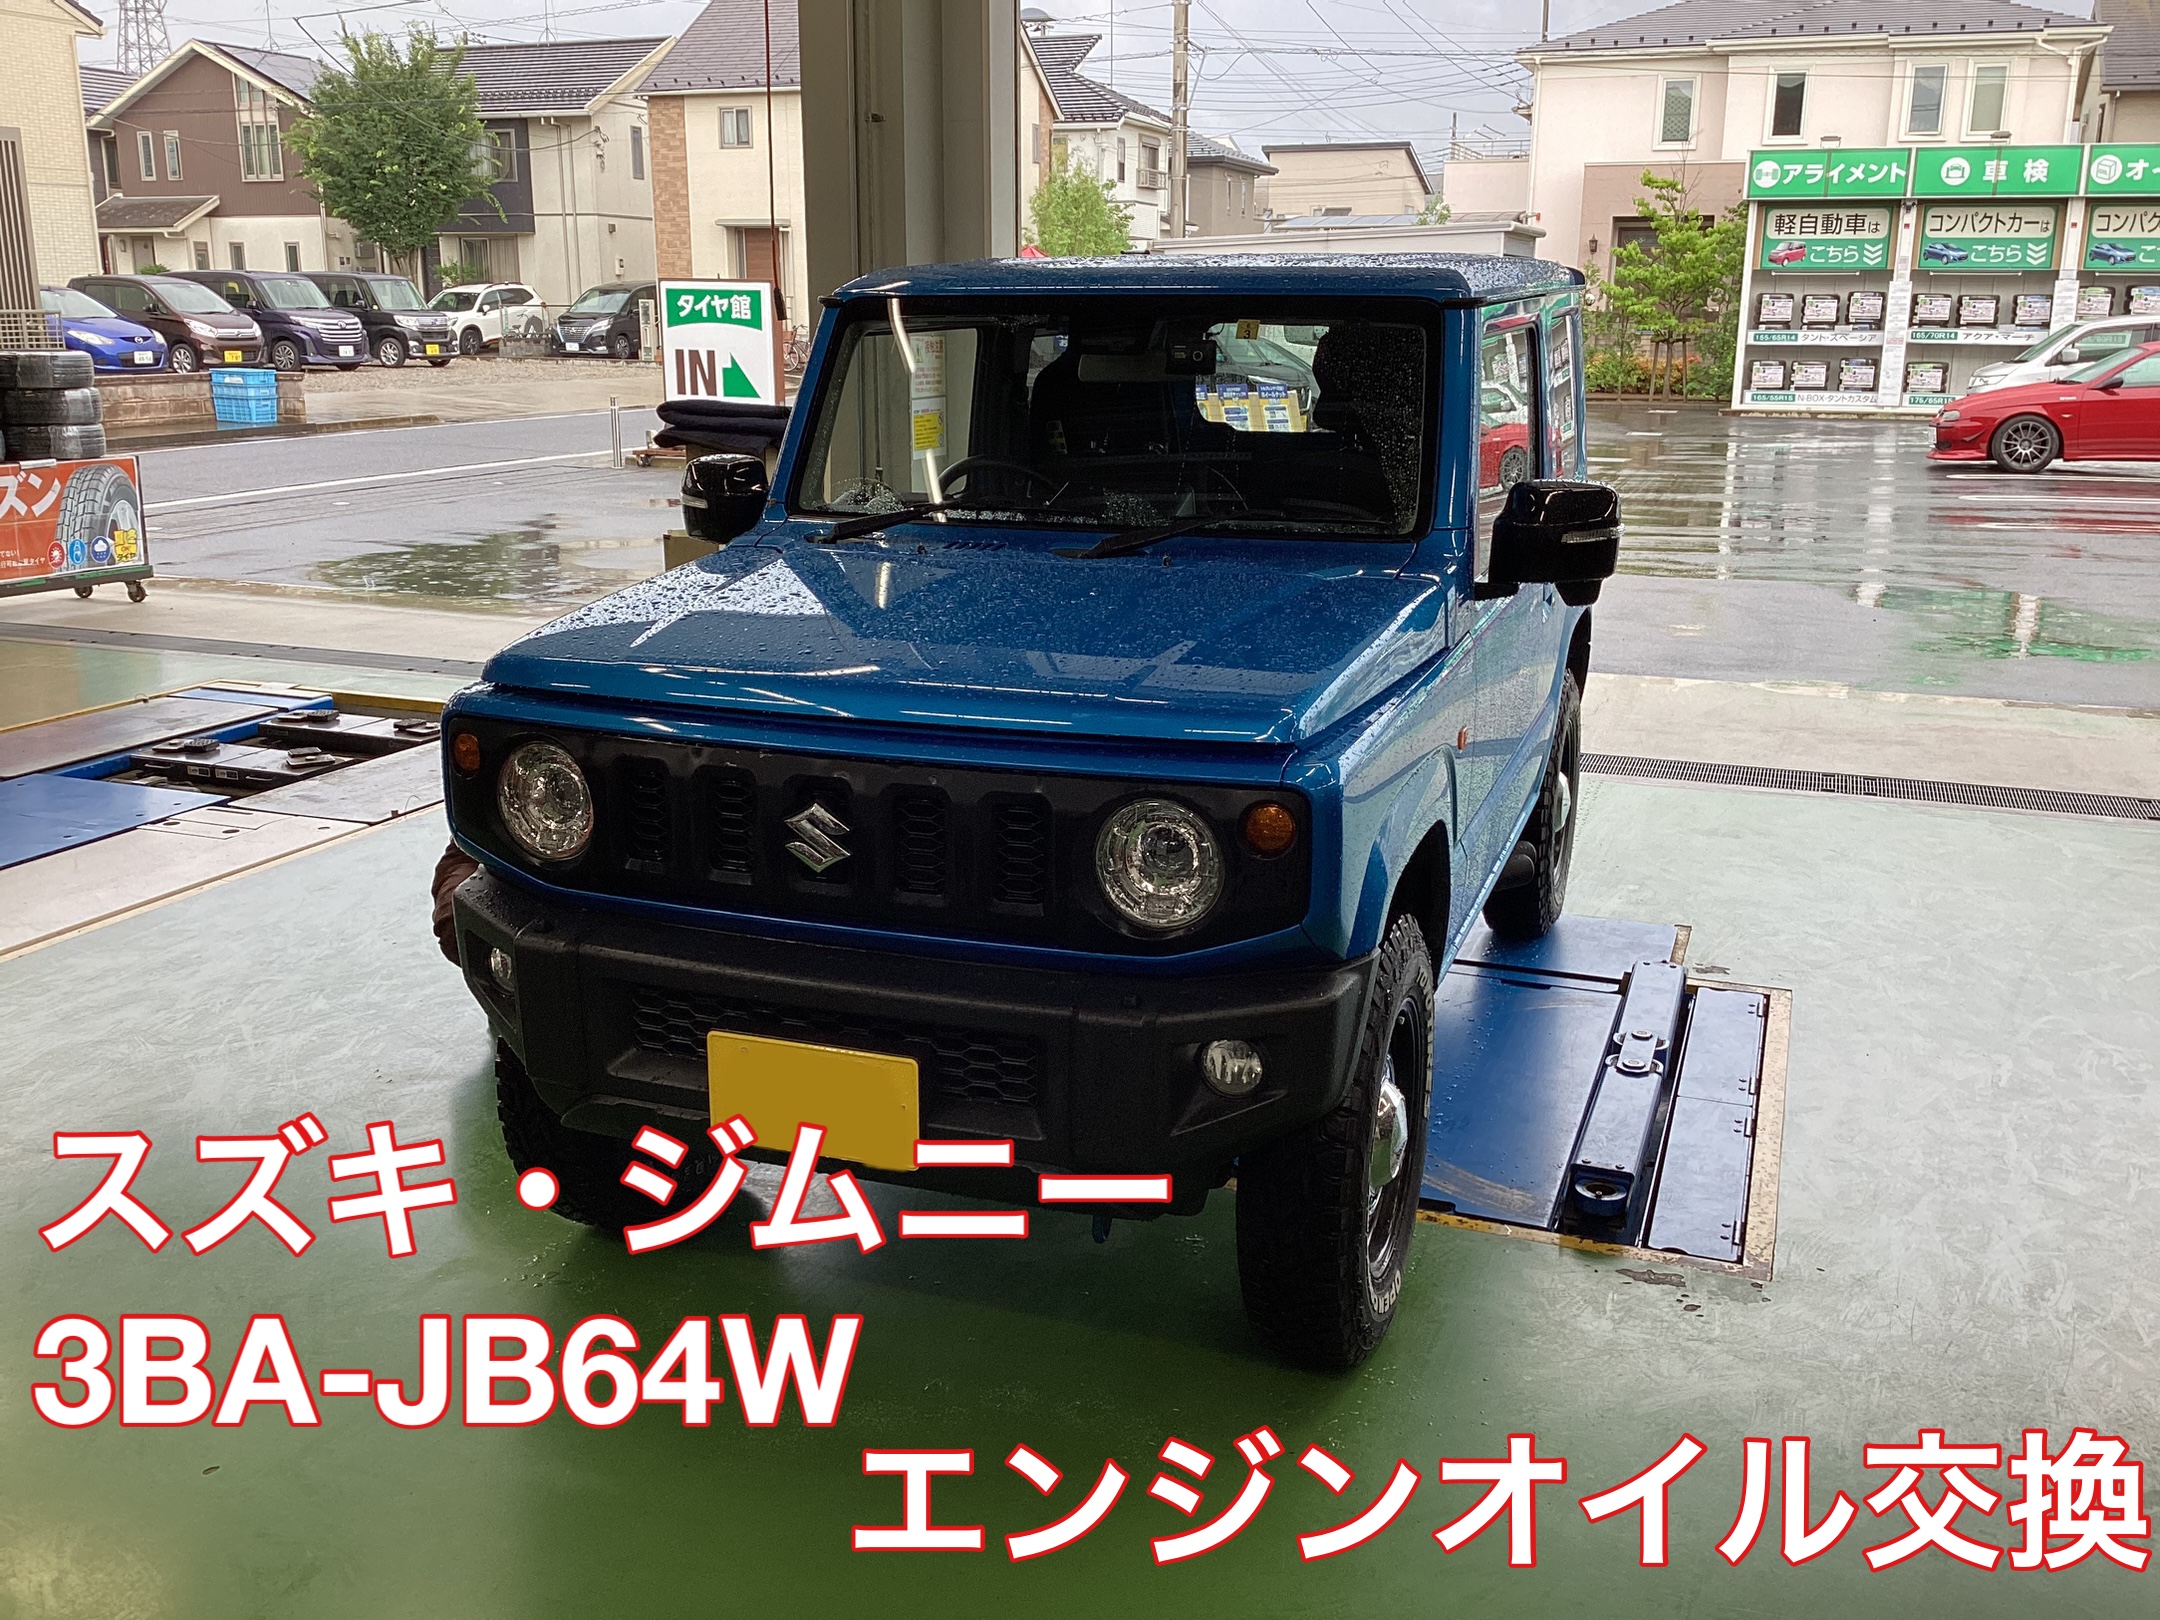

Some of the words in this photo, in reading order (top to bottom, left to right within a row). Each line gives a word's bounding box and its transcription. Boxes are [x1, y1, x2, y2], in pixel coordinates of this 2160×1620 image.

[1782, 162, 1907, 185] アライメント
[1982, 158, 2050, 183] 車検
[2125, 158, 2160, 181] オ
[1774, 212, 1881, 236] 軽自動車は
[1929, 211, 2051, 234] コンパクトカーは
[1810, 245, 1859, 264] こちら
[1970, 244, 2022, 263] こちら
[676, 294, 752, 320] タイヤ館
[1243, 329, 1251, 339] 3
[1754, 333, 1796, 341] 155/65R14
[1911, 331, 1956, 340] 165/70R14
[1961, 332, 2035, 341] アクア・マーチ
[674, 348, 718, 397] IN
[1752, 393, 1794, 401] 165/55R15
